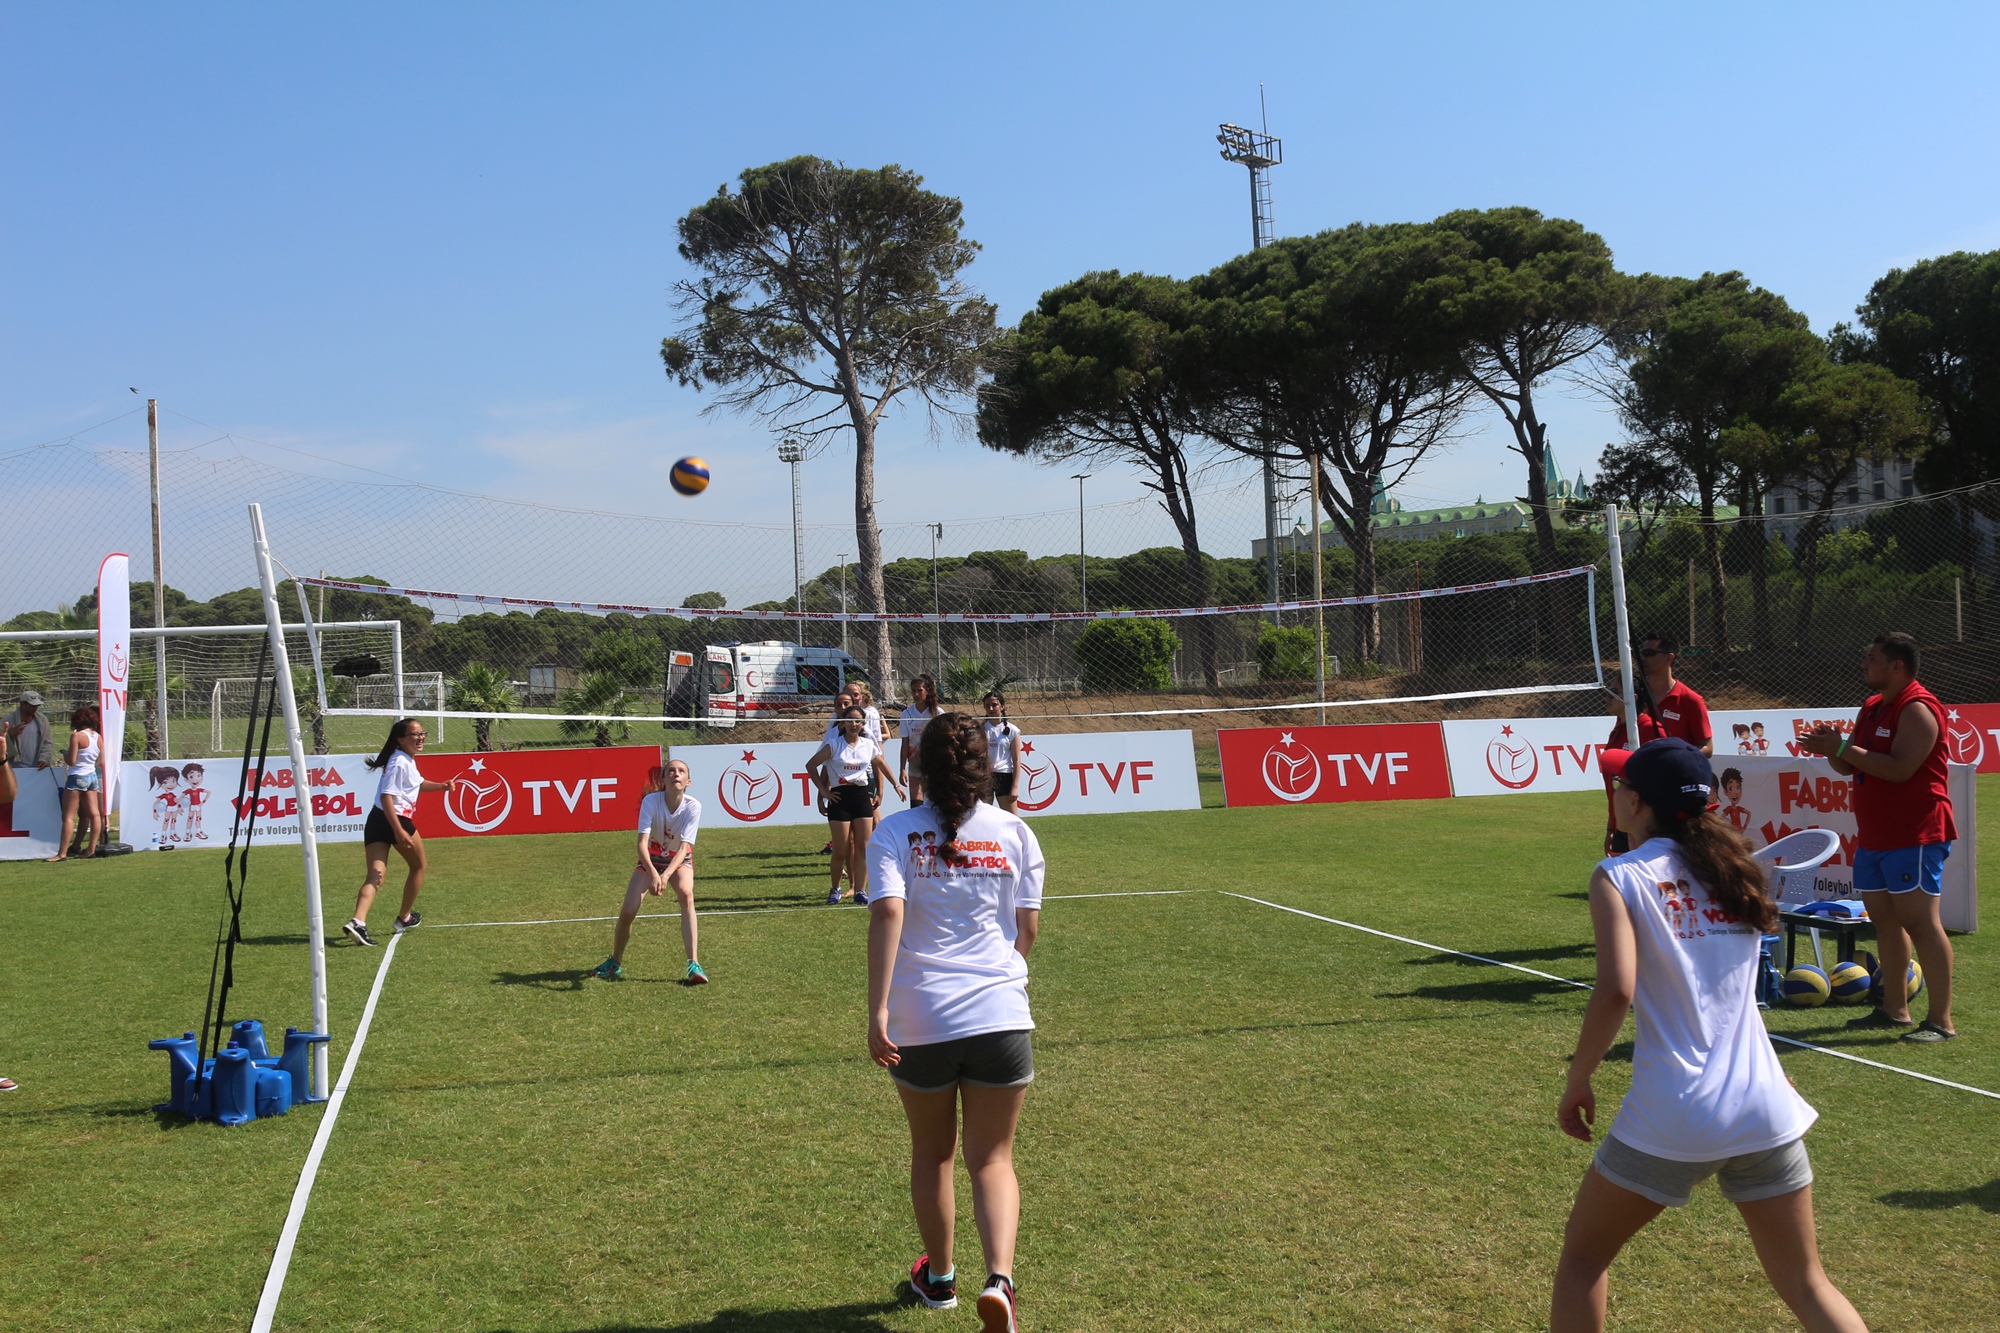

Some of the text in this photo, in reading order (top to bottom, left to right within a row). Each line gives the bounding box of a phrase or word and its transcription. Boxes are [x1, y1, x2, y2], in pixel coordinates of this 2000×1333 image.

[1069, 761, 1153, 796] TVF
[1327, 752, 1409, 787] TVF
[231, 792, 362, 821] VOLEBOL
[522, 778, 618, 816] TVF
[228, 824, 365, 836] Trkye Voleyb ederasyon
